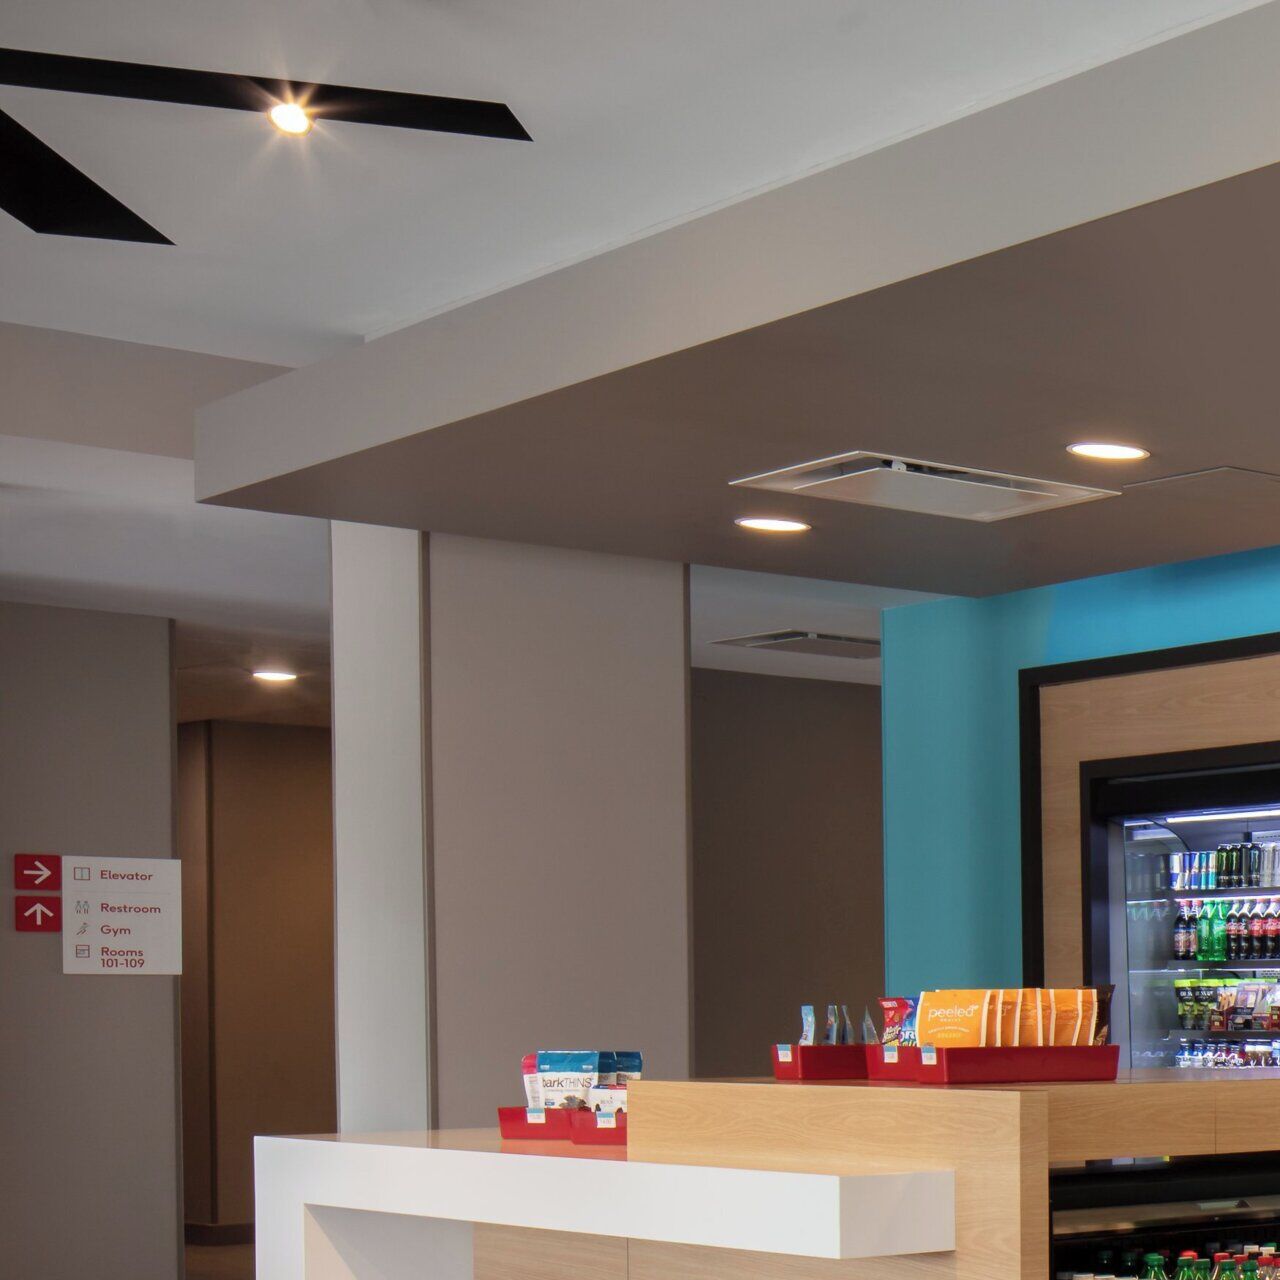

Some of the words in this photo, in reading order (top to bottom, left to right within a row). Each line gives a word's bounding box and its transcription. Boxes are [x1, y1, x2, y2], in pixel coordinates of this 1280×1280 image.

[100, 869, 153, 881] Elevator
[100, 903, 161, 914] Restroom
[100, 925, 131, 937] Gym
[100, 947, 144, 957] Rooms
[100, 958, 145, 968] 101-109
